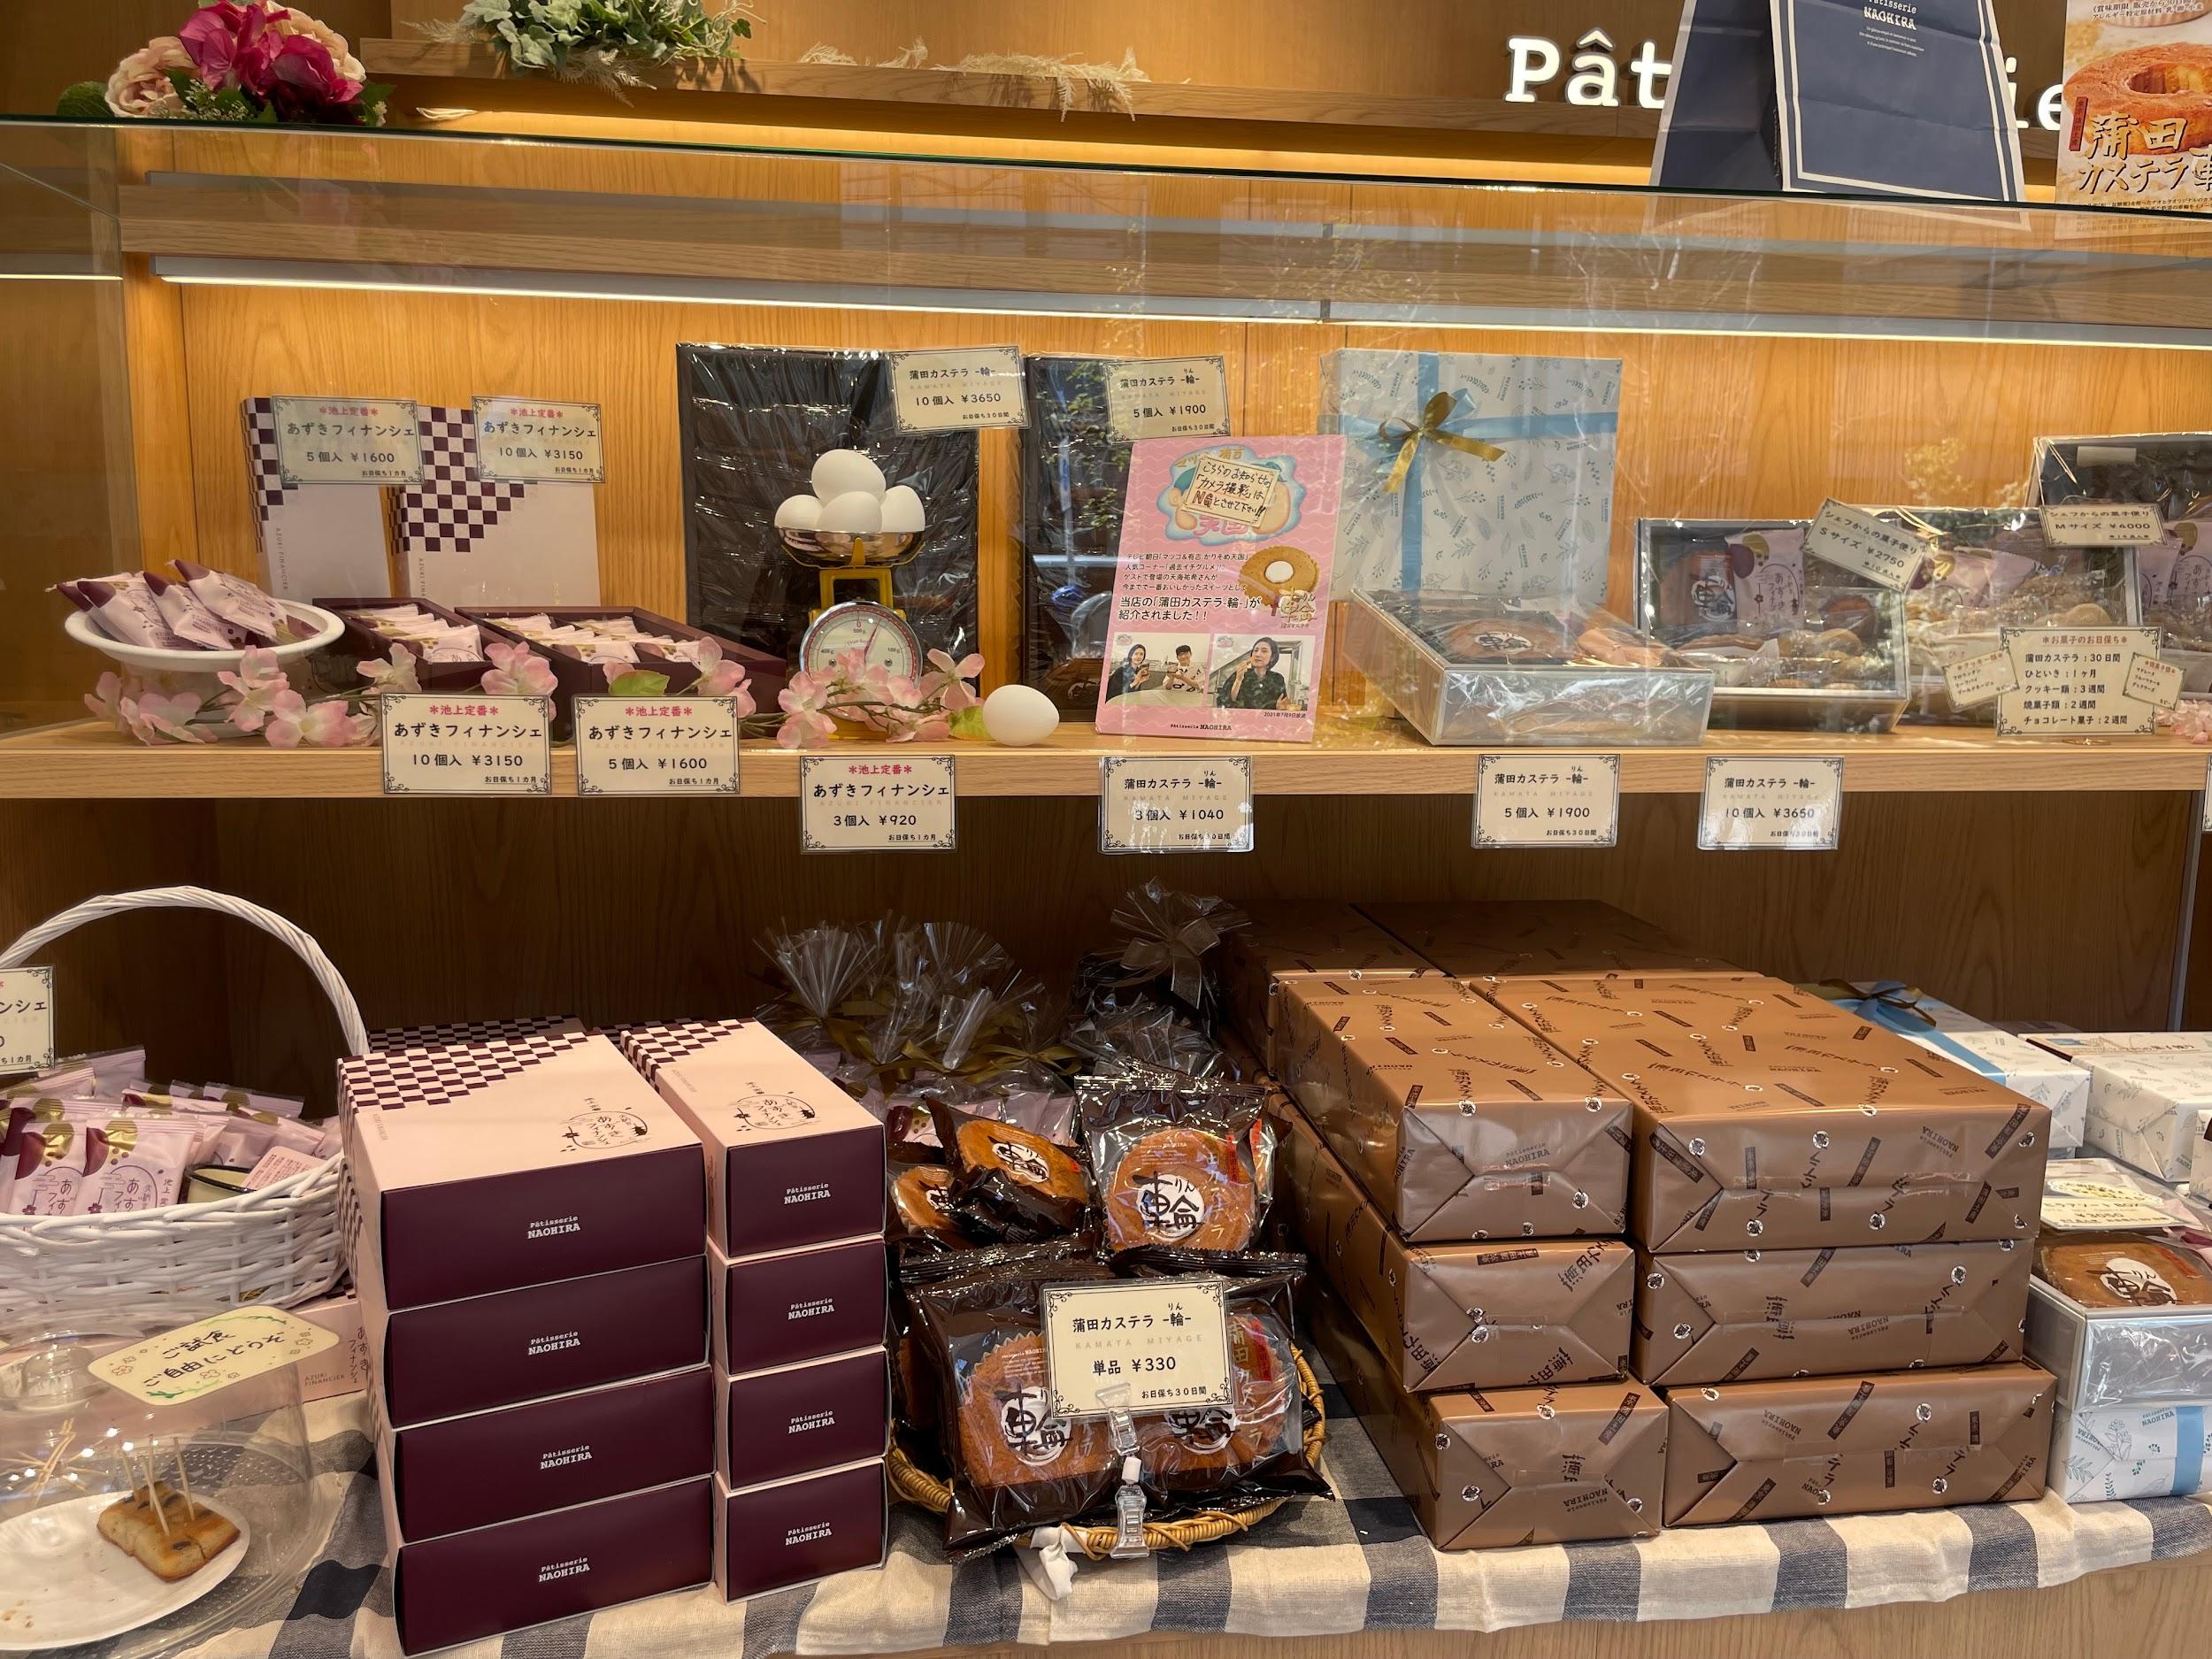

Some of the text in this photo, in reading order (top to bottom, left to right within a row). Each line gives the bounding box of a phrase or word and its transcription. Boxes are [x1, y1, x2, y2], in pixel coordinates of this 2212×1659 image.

[1863, 6, 1917, 30] NAOHIRA
[2085, 112, 2188, 161] 蒲田
[909, 368, 969, 380] 蒲田カステラ
[916, 393, 1002, 406] 10個入 ¥3650
[1133, 404, 1206, 419] 5個入 ¥1900
[287, 422, 415, 436] あずきフィナンシェ
[484, 421, 597, 438] あずきフィナンシェ
[307, 451, 396, 463] 5個入 ¥1600
[499, 447, 584, 460] 10個入 ¥3150
[1203, 461, 1271, 488] こちらのお知らせの
[1867, 547, 1905, 568] ¥2750
[394, 722, 542, 738] あずきフィナンシェ
[589, 726, 733, 740] あずきフィナンシェ
[413, 754, 523, 766] 10個入 ¥3150
[609, 758, 707, 770] 5個入 ¥1600
[1124, 779, 1191, 790] 蒲田カステラ
[1494, 773, 1559, 785] 蒲田カステラ
[1724, 778, 1786, 788] 蒲田カステラ
[813, 783, 949, 798] あずきフィナンシェ
[1134, 810, 1224, 821] 3個入 ¥1040
[1504, 807, 1590, 818] 5個入 ¥1900
[1725, 808, 1815, 818] 10個入 ¥3650
[833, 815, 917, 826] 3個入 ¥920
[1505, 1148, 1551, 1167] NAOHIRA
[786, 1182, 829, 1194] Pâtisserie
[784, 1189, 831, 1204] NAOHIRA
[530, 1215, 579, 1228] Pâtisserie
[526, 1222, 581, 1239] NAOHIRA
[790, 1297, 833, 1310] Pâtisserie
[1168, 1302, 1183, 1310] りん
[787, 1304, 835, 1320] NAOHIRA
[1072, 1314, 1154, 1333] 蒲田カステラ
[162, 1330, 235, 1360] ご試食
[531, 1331, 579, 1345] Pâtisserie
[527, 1338, 581, 1356] NAOHIRA
[142, 1331, 285, 1387] ご自由にどうぞ
[1093, 1356, 1177, 1376] 単品 ¥330
[1141, 1386, 1207, 1399] お日保ち30日間
[790, 1409, 833, 1425] Pâtisserie
[787, 1417, 835, 1434] NAOHIRA
[542, 1445, 590, 1459] Pâtisserie
[540, 1451, 593, 1470] NAOHIRA
[787, 1521, 831, 1536] Pâtisserie
[785, 1528, 833, 1546] NAOHIRA
[541, 1556, 588, 1572] Pâtisserie
[538, 1563, 591, 1583] NAOHIRA
